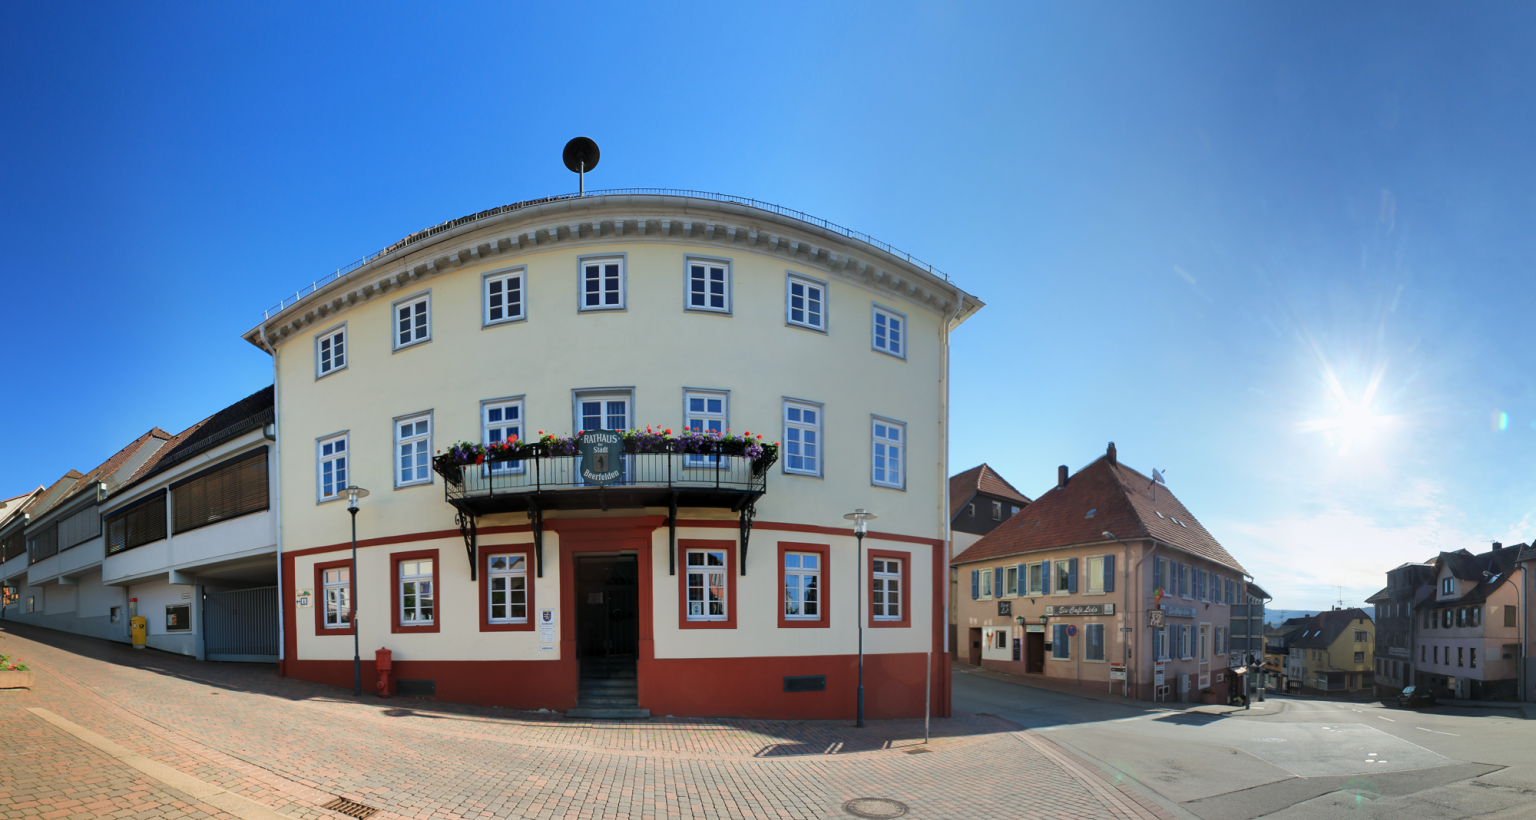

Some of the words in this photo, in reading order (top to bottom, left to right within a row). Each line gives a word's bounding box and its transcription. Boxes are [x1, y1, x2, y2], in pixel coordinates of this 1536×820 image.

[583, 434, 618, 443] RATHAUS
[583, 469, 620, 480] Beerfelden
[1084, 605, 1098, 613] Lido
